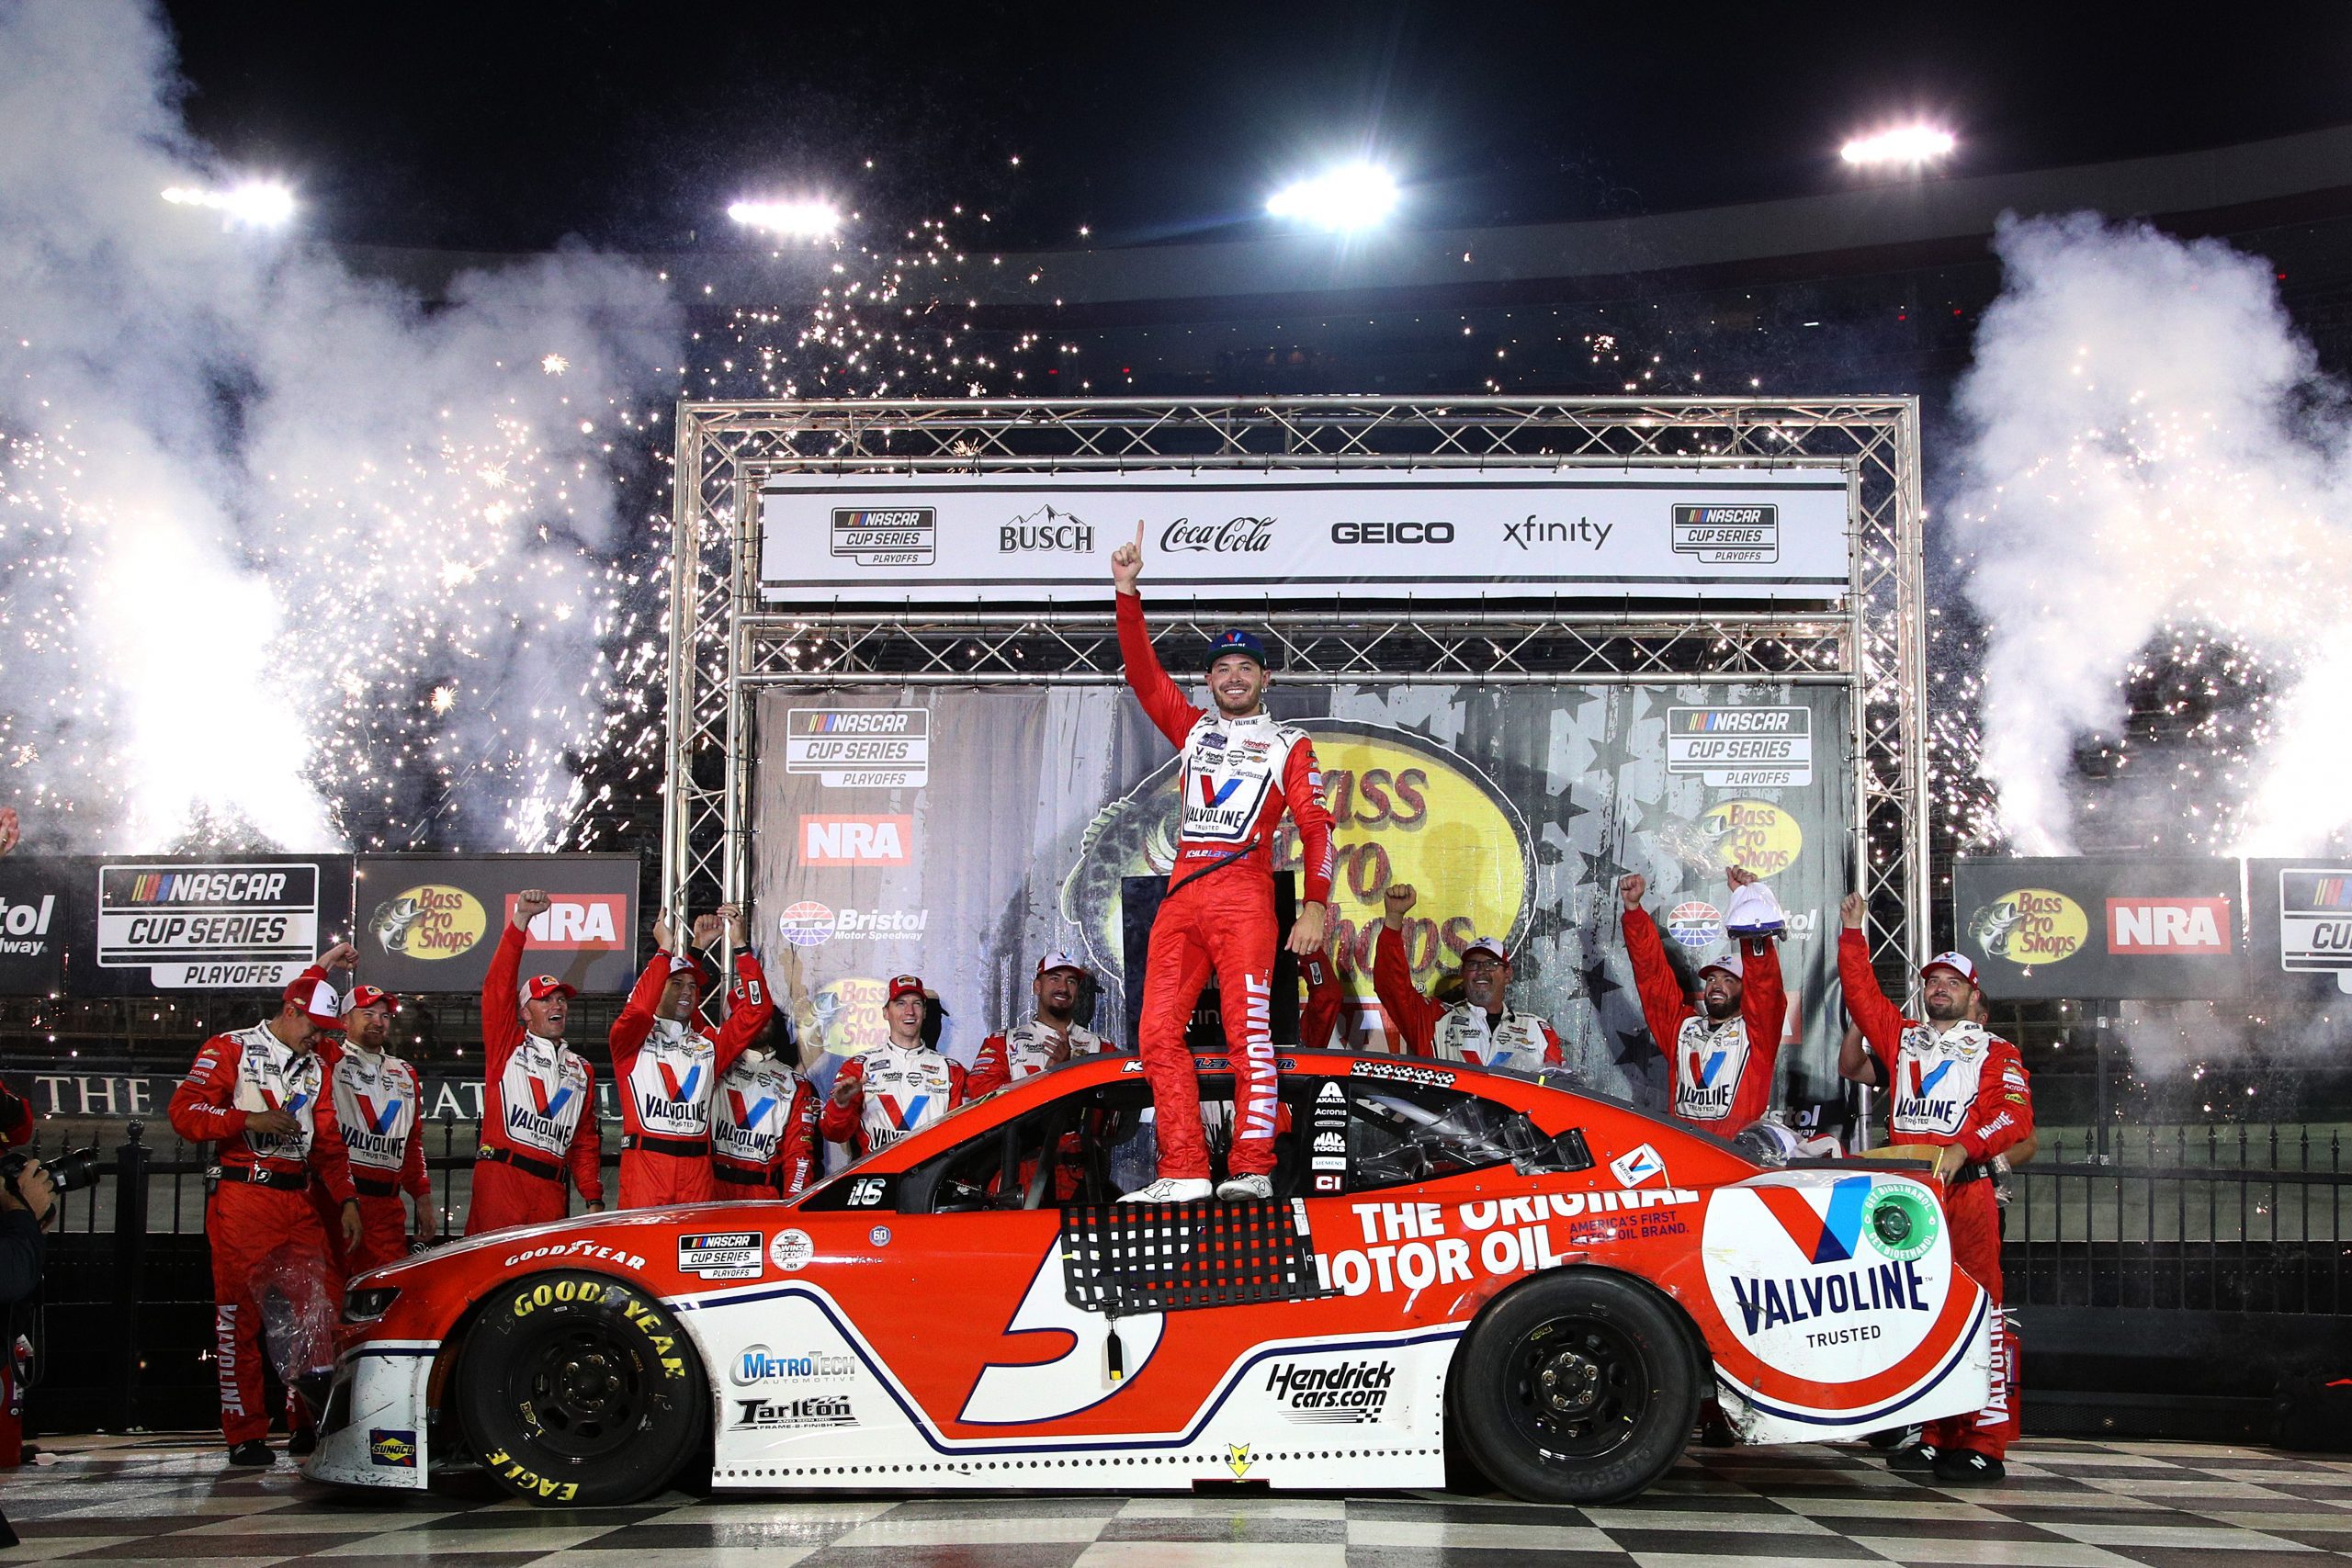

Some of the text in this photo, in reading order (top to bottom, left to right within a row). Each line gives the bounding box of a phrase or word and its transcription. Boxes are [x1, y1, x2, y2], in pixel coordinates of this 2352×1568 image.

[865, 512, 920, 526] NASCAR
[1703, 509, 1761, 524] NASCAR
[846, 532, 921, 546] CUP SERIES
[998, 525, 1095, 554] BUSCH
[1330, 521, 1455, 545] GEICO
[1502, 514, 1614, 550] xfinity
[1687, 529, 1762, 543] CUP SERIES
[872, 553, 920, 564] PLAYOFFS
[1713, 550, 1762, 561] PLAYOFFS
[831, 714, 909, 732] NASCAR
[1713, 713, 1790, 731] NASCAR
[806, 741, 909, 760] CUP SERIES
[1687, 740, 1792, 759] CUP SERIES
[842, 773, 907, 785] PLAYOFFS
[1725, 772, 1791, 784] PLAYOFFS
[1185, 805, 1244, 829] VALVOLINE
[1728, 805, 1776, 827] Bass
[807, 822, 903, 859] NRA
[1730, 826, 1766, 846] Pro
[1733, 845, 1789, 874] Shops
[168, 873, 287, 902] NASCAR
[418, 887, 463, 909] Bass
[2018, 892, 2063, 916] Bass
[418, 908, 453, 929] Pro
[836, 909, 929, 931] Bristol
[2019, 913, 2054, 934] Pro
[2115, 906, 2221, 945] NRA
[128, 917, 288, 945] CUP SERIES
[417, 926, 474, 953] Shops
[834, 931, 923, 942] Motor Speedway
[2312, 922, 2352, 950] CU
[2019, 931, 2076, 956] Shops
[184, 965, 284, 985] PLAYOFFS
[841, 1003, 877, 1023] Pro
[1240, 973, 1278, 1140] VALVOLINE
[35, 1075, 153, 1116] THE
[645, 1093, 707, 1122] VALVOLINE
[1314, 1108, 1347, 1116] Acronis
[1689, 1104, 1715, 1112] TRUSTED
[509, 1103, 572, 1148] VALVOLINE
[715, 1118, 775, 1155] VALVOLINE
[341, 1122, 406, 1160] VALVOLINE
[529, 1132, 555, 1145] TRUSTED
[1313, 1131, 1347, 1146] MAC
[361, 1150, 390, 1161] TRUSTED
[1316, 1175, 1341, 1190] CI
[1616, 1158, 1638, 1184] VALVOLINE
[851, 1178, 887, 1206] 16
[1864, 1185, 1933, 1213] GET BIOETHANOL
[1351, 1201, 1446, 1245] THE
[1458, 1190, 1700, 1232] ORIGINAL
[1569, 1211, 1677, 1235] AMERICA'S FIRST
[706, 1235, 751, 1247] NASCAR
[1618, 1228, 1638, 1241] OIL
[1641, 1223, 1690, 1238] BRAND.
[504, 1239, 647, 1270] GOODYEAR
[1480, 1224, 1565, 1277] OIL
[1868, 1232, 1936, 1259] GET BIOETHANOL
[690, 1251, 752, 1264] CUP SERIES
[712, 1269, 751, 1278] PLAYOFFS
[1730, 1259, 1929, 1337] VALVOLINE
[514, 1280, 686, 1380] GOODYEAR
[956, 1227, 1167, 1426] 5
[1805, 1325, 1882, 1348] TRUSTED
[217, 1304, 245, 1416] VALVOLINE
[1975, 1302, 2010, 1427] VALVOLINE
[763, 1376, 855, 1385] AUTOMOTIVE
[1265, 1360, 1396, 1401] Hendrick
[1291, 1390, 1387, 1408] cars.com
[734, 1397, 854, 1425] Tarlton
[373, 1444, 414, 1454] SUNOCO
